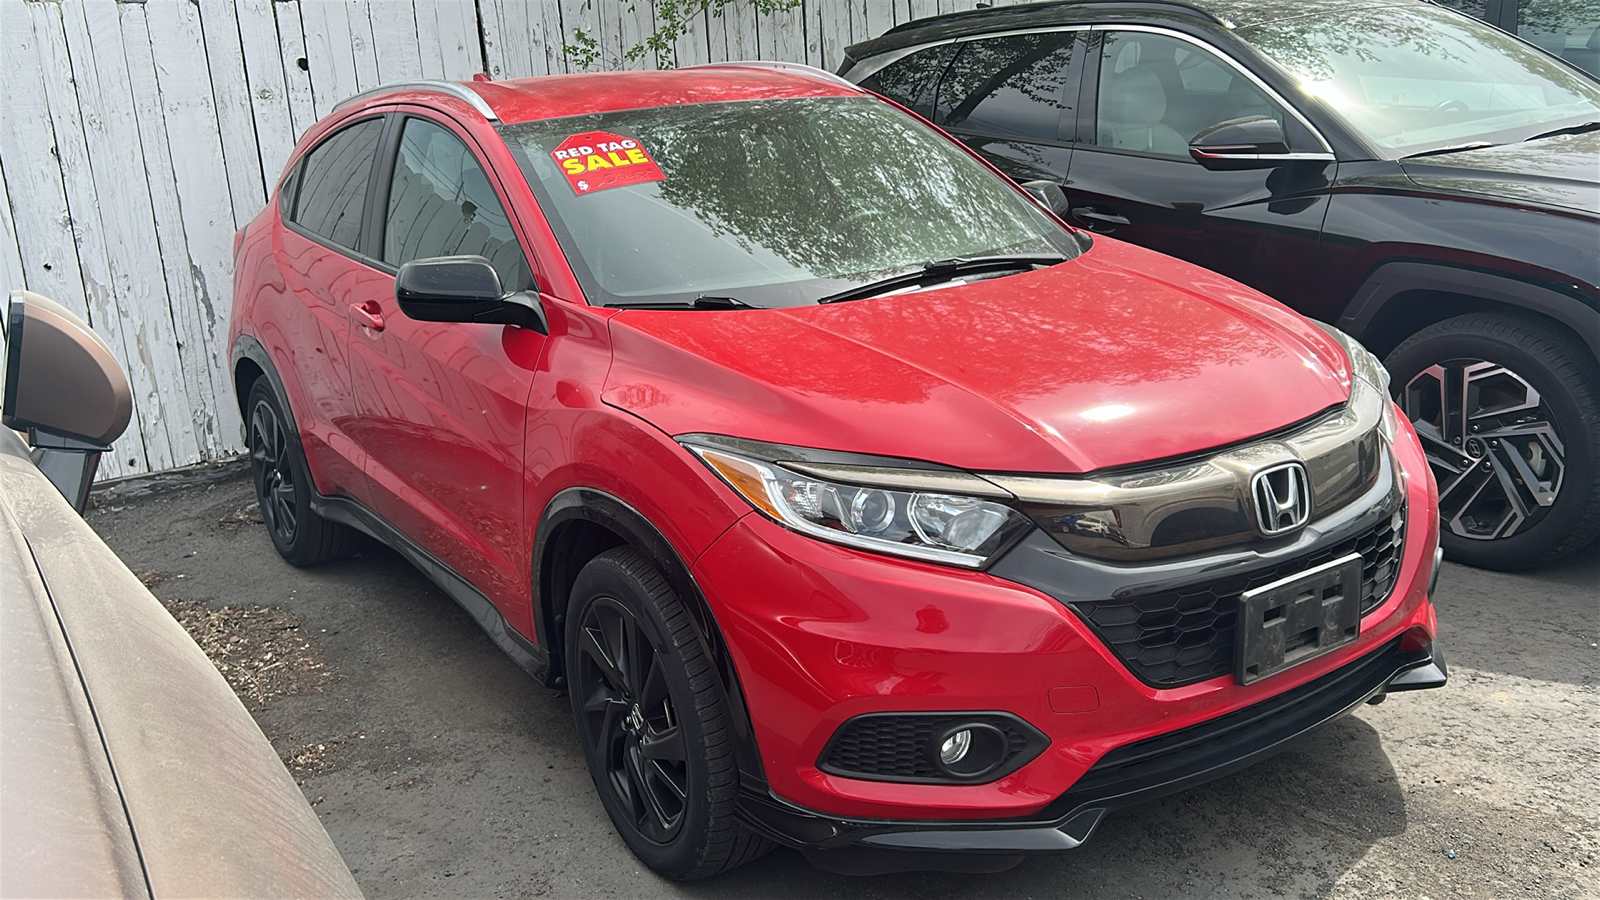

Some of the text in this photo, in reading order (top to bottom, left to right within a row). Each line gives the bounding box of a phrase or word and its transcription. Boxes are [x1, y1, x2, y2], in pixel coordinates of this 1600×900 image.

[554, 139, 637, 160] RED TAG
[562, 148, 649, 175] SALE
